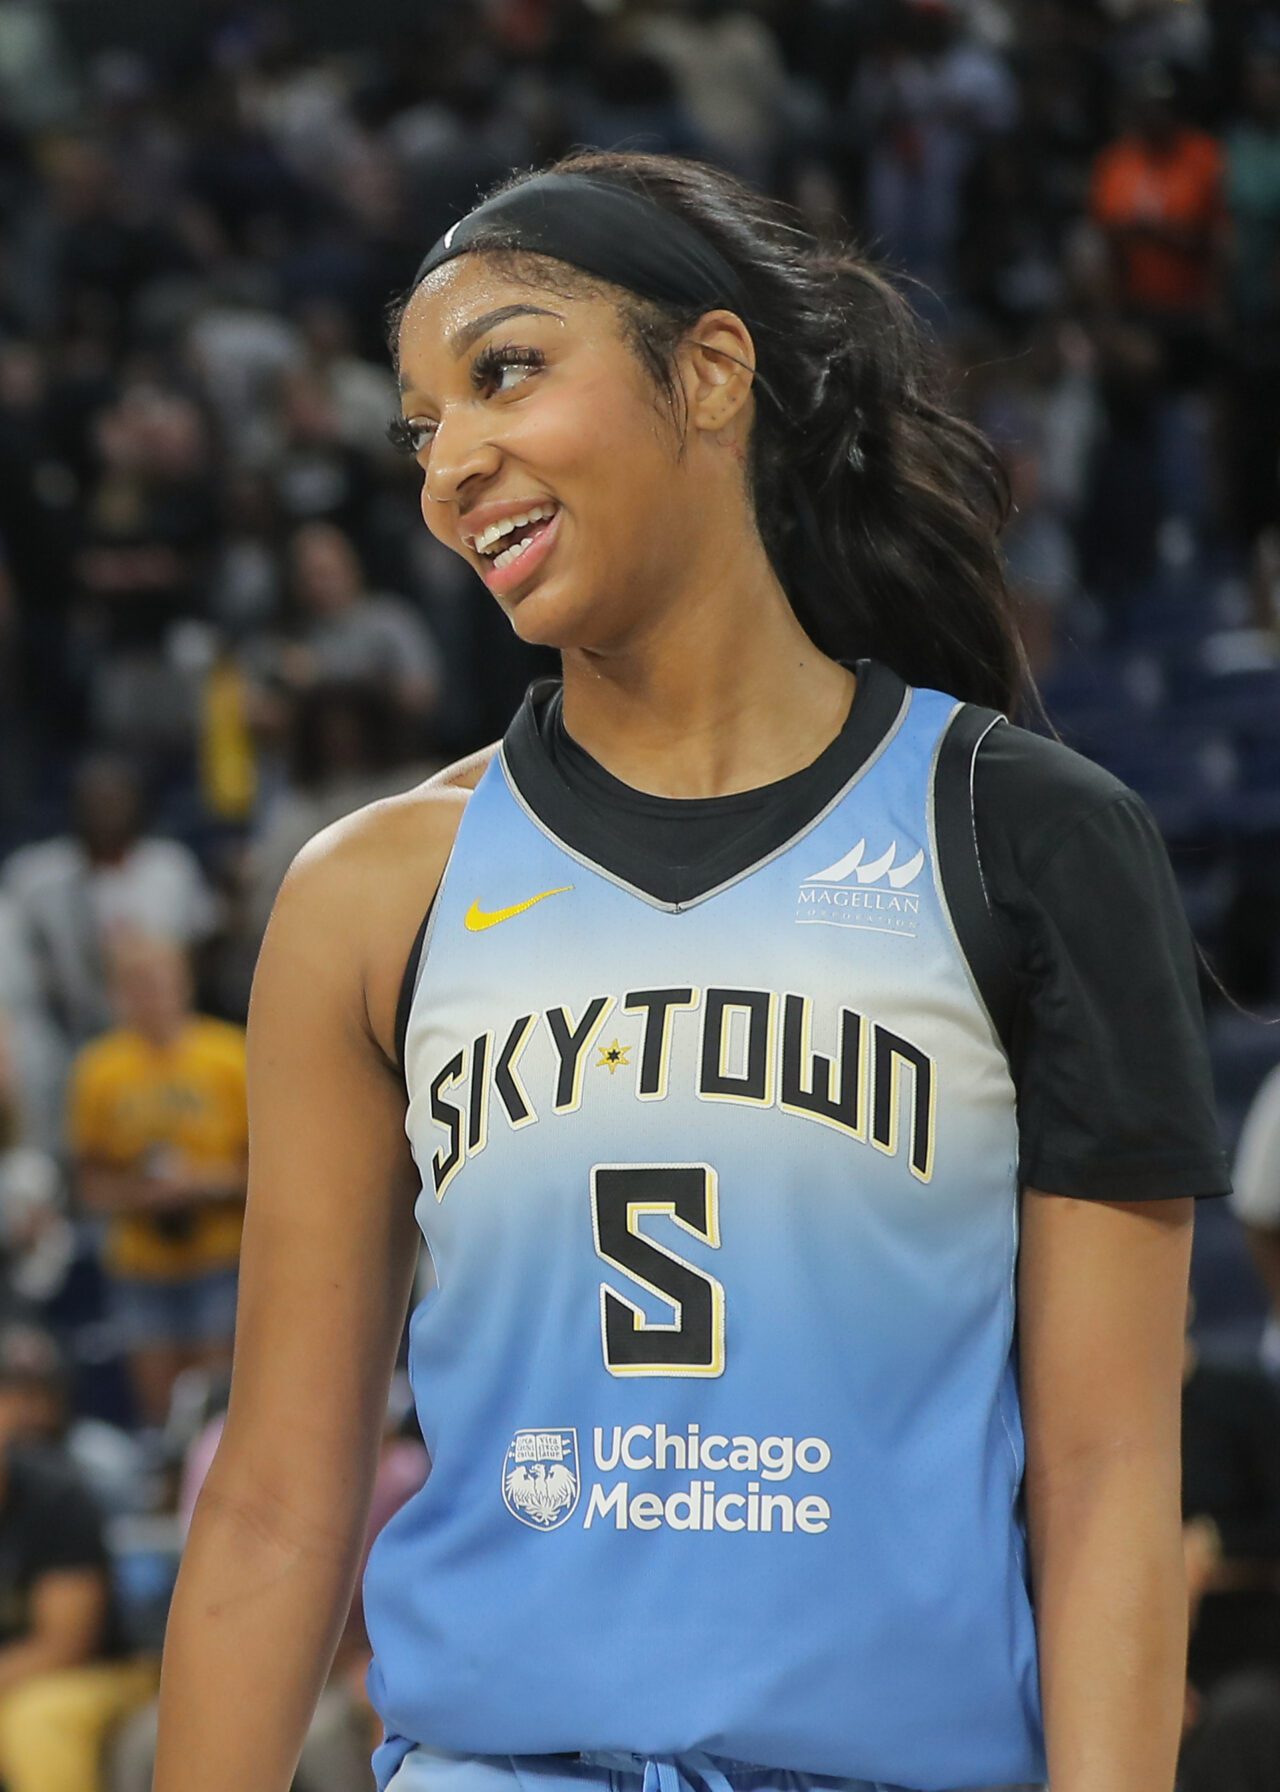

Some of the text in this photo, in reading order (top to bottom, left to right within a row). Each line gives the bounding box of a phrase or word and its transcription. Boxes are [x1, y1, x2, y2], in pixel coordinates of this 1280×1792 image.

[797, 889, 920, 914] MAGELLAN
[590, 1162, 725, 1379] 5
[593, 1423, 832, 1481] UChicago
[583, 1480, 832, 1534] Medicine
